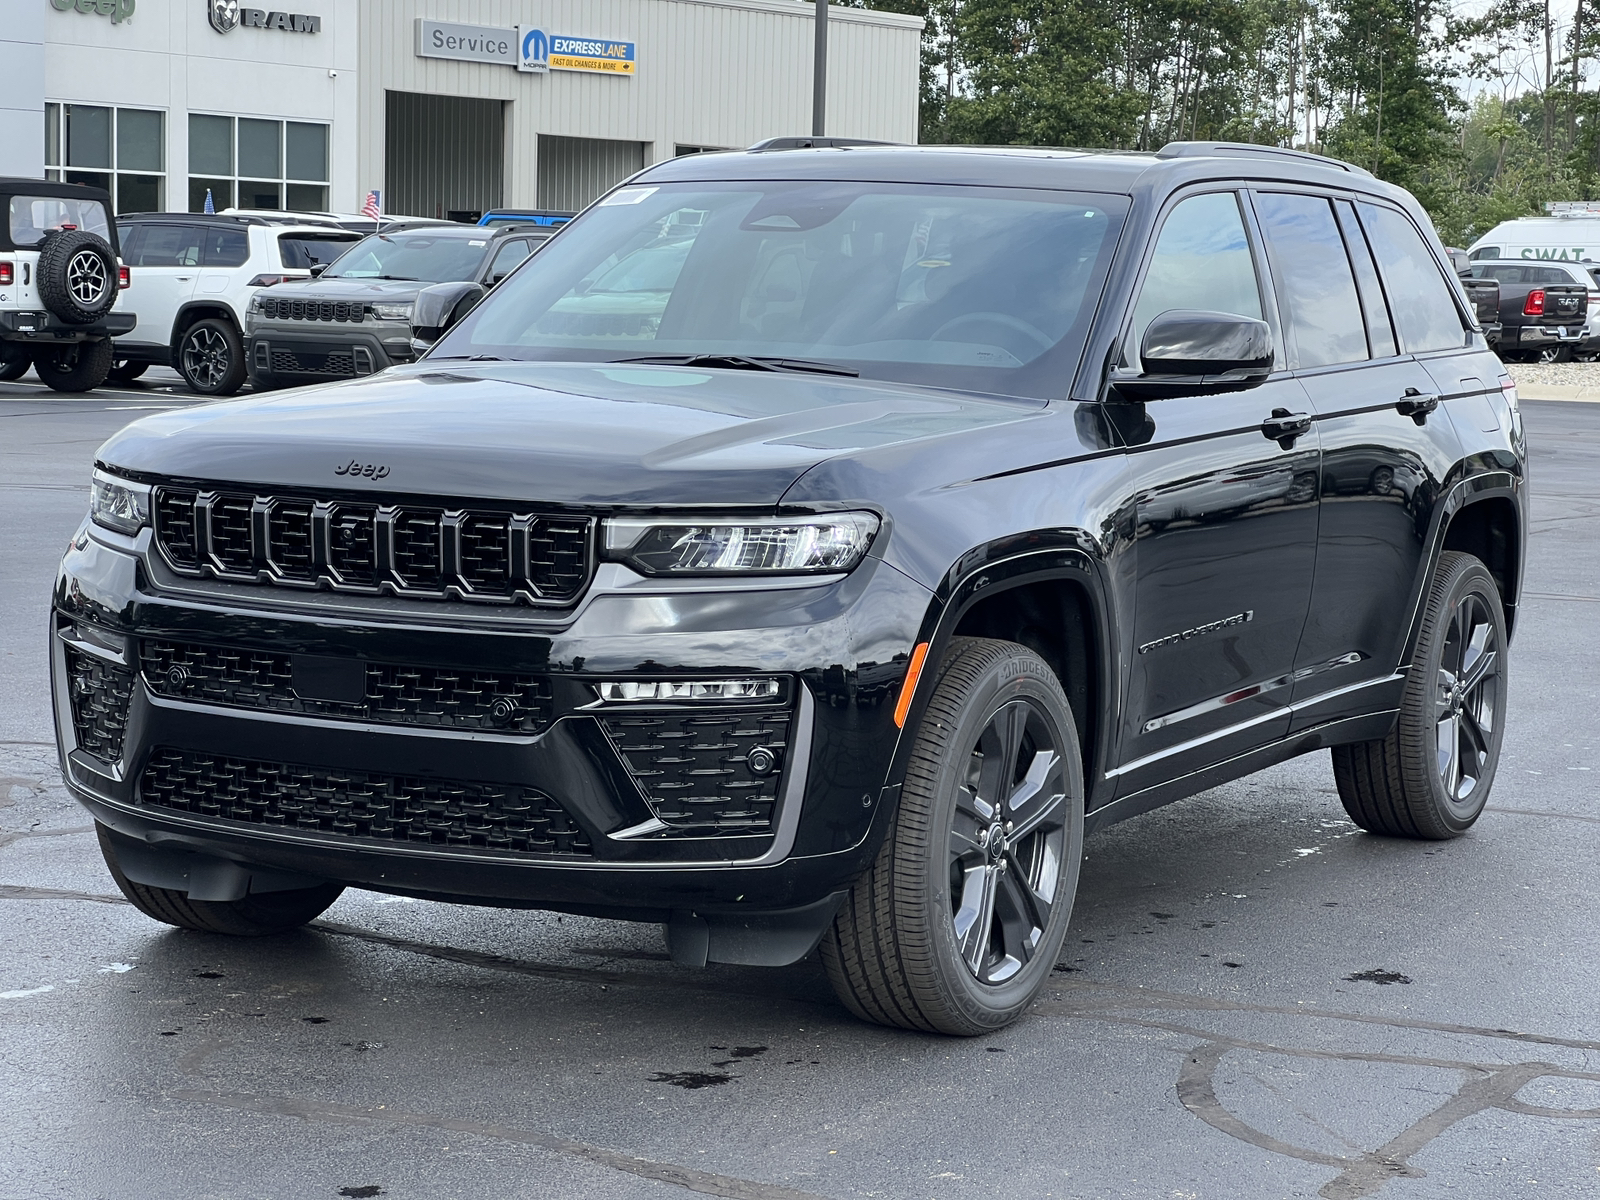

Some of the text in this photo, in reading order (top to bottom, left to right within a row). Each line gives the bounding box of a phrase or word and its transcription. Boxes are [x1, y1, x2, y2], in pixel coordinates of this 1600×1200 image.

[241, 8, 322, 33] RAM
[432, 29, 508, 54] Service
[523, 62, 547, 70] MOPAR
[552, 58, 565, 66] FAST
[565, 59, 574, 67] OIL
[574, 59, 598, 69] CHANGES
[602, 62, 617, 70] MORE
[1521, 248, 1585, 261] SWAT
[335, 459, 390, 481] Jeep
